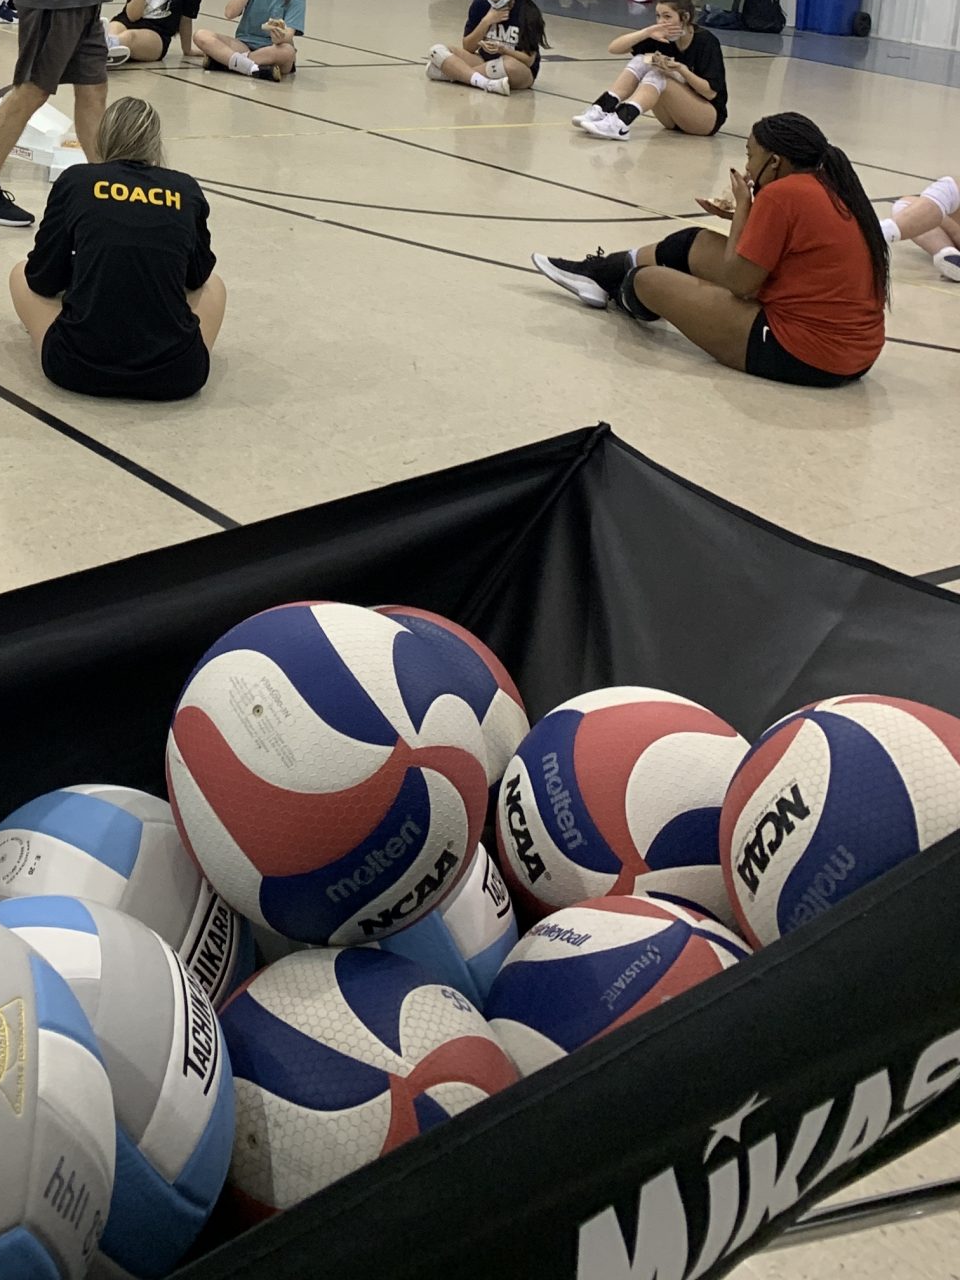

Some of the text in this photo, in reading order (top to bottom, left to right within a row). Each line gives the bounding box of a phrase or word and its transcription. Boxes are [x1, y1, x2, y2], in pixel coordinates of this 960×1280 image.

[486, 23, 520, 44] AMS
[93, 180, 181, 210] COACH
[506, 774, 546, 884] NCAA
[542, 752, 584, 850] molten
[737, 783, 811, 895] NCAA
[326, 821, 421, 902] molten
[358, 849, 458, 936] NCAA
[193, 905, 230, 996] HIKARA
